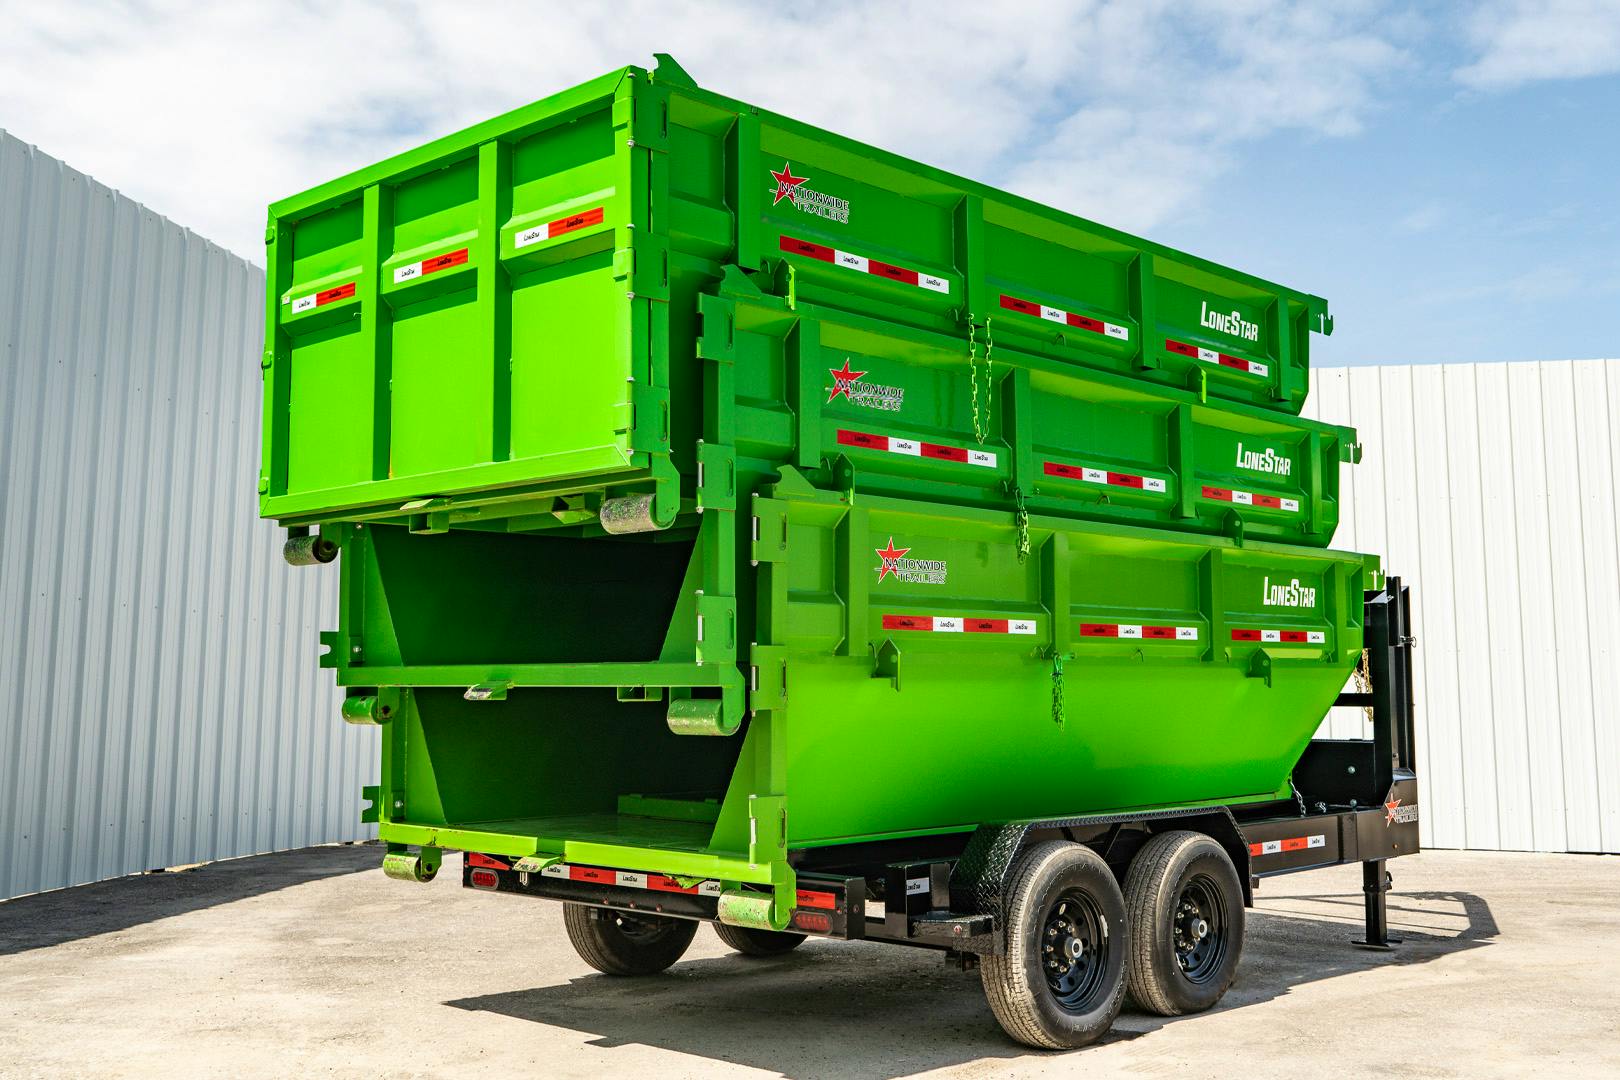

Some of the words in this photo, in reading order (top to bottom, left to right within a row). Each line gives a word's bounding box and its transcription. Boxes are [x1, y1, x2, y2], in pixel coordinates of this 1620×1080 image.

[780, 180, 850, 211] NATIONWIDE
[796, 200, 849, 224] TRAILERS
[836, 378, 904, 399] NATIONWIDE
[850, 395, 902, 412] TRAILERS
[884, 557, 947, 572] NATIONWIDE
[899, 572, 946, 584] TRAILERS
